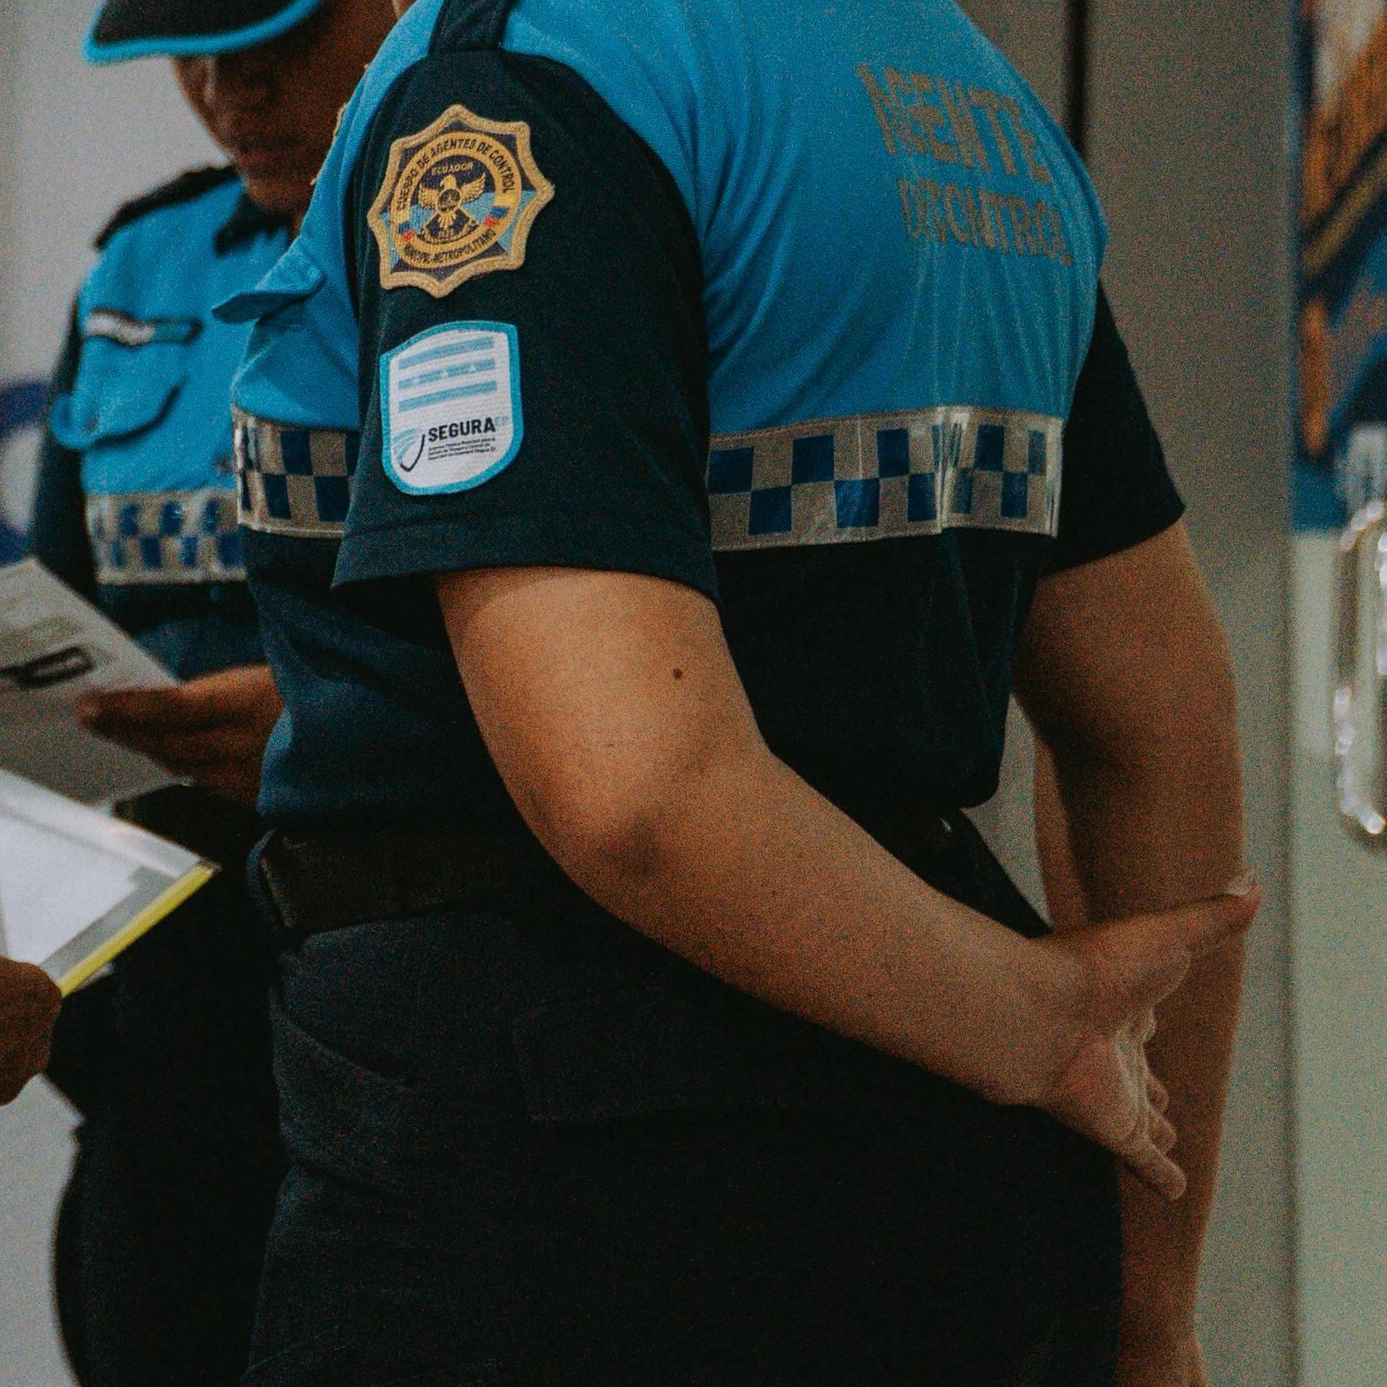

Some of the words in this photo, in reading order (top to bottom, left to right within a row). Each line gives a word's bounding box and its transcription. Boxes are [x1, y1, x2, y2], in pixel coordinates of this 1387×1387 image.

[430, 138, 477, 159] AGENTES
[476, 141, 493, 156] DE
[488, 149, 515, 194] CONTROL
[431, 161, 475, 175] ECUADOR
[428, 417, 496, 442] SEGURA
